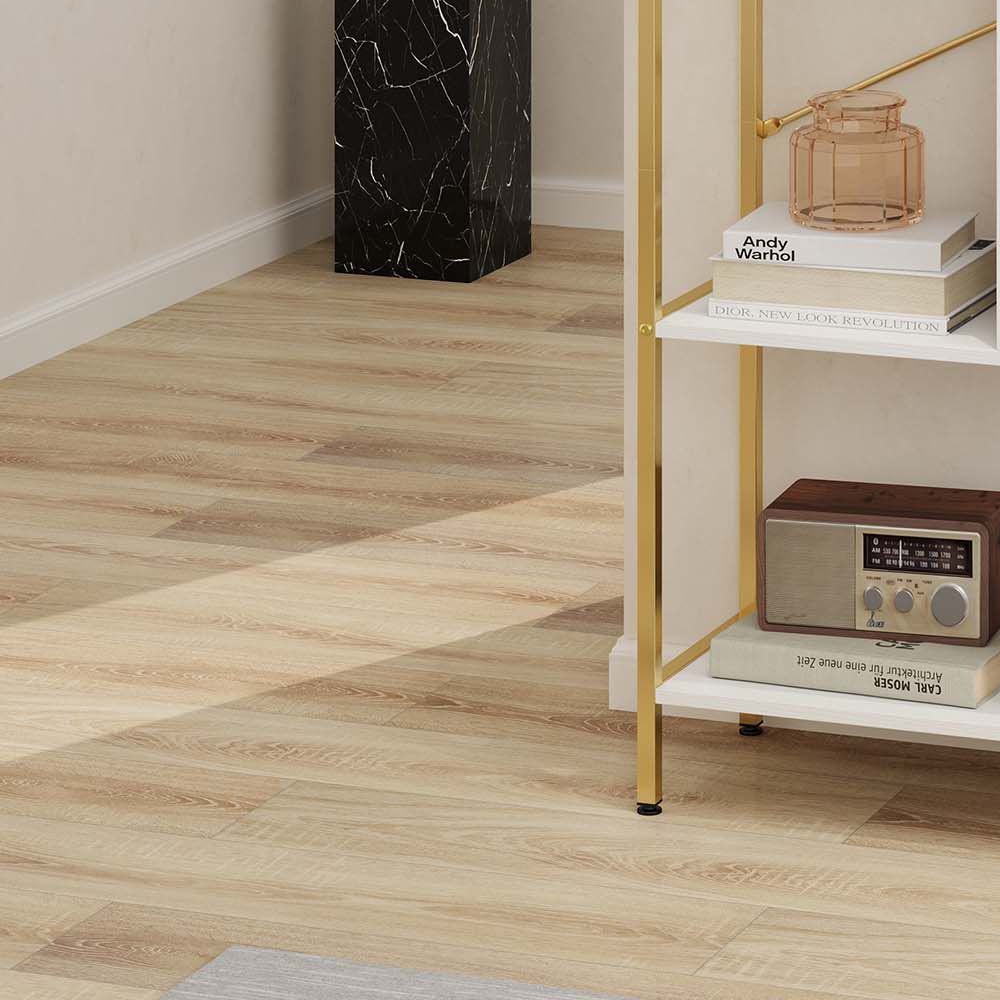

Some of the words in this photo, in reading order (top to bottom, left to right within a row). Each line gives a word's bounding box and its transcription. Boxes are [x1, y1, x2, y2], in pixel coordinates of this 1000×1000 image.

[742, 236, 788, 252] Andy
[735, 248, 796, 262] Warhol
[758, 309, 793, 321] NEW
[797, 311, 839, 325] LOOK
[842, 315, 940, 333] REVOLUTION
[796, 655, 816, 669] Zeit
[818, 657, 843, 669] neue
[845, 660, 867, 675] eine
[869, 663, 884, 677] für
[887, 665, 943, 683] Architektur
[874, 676, 911, 692] MOSER
[914, 681, 942, 696] CARL
